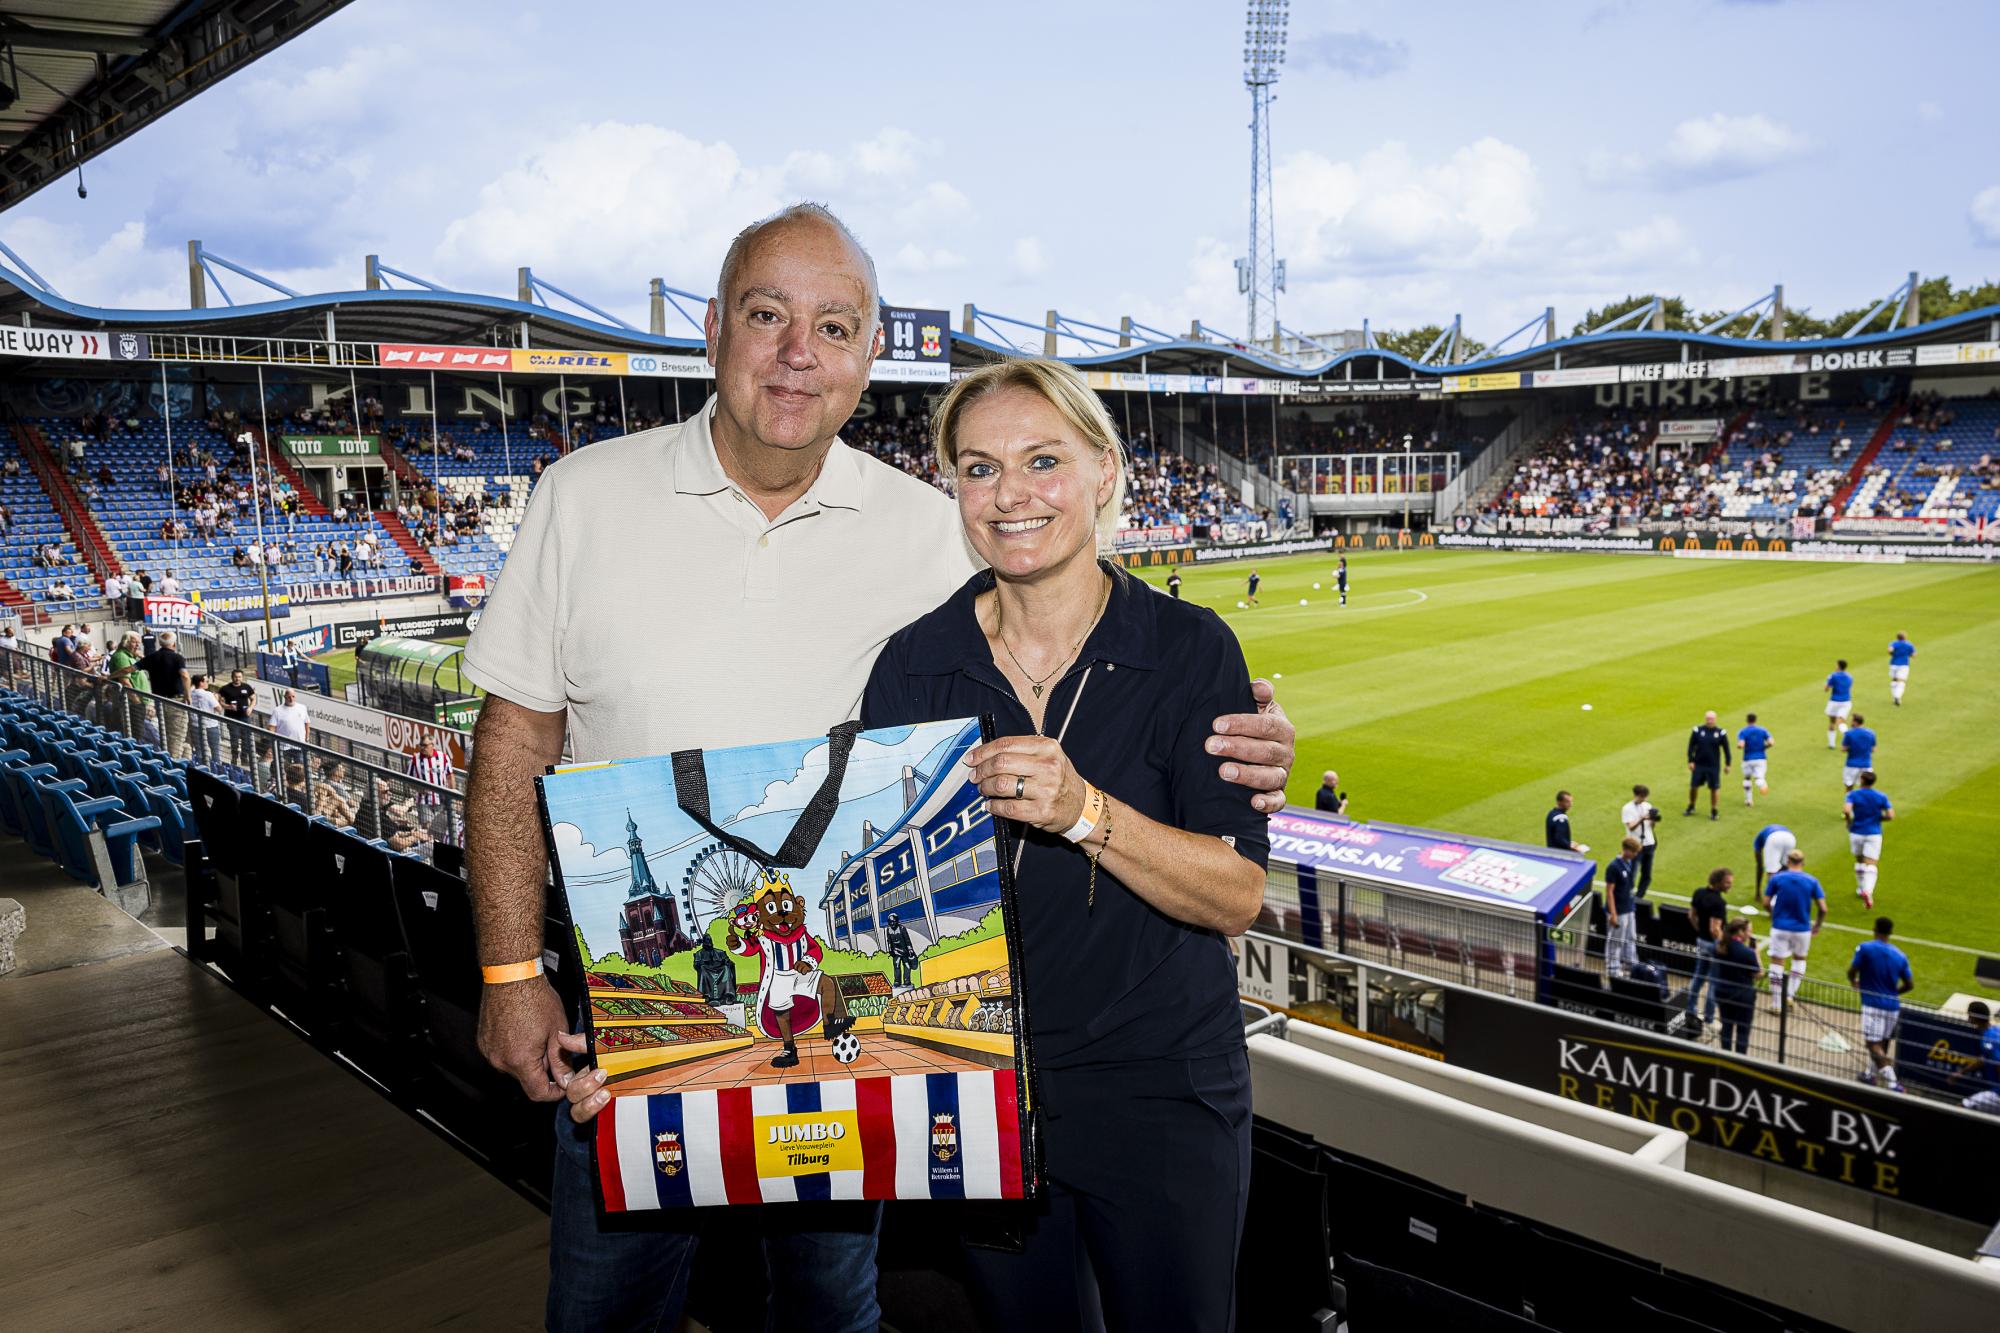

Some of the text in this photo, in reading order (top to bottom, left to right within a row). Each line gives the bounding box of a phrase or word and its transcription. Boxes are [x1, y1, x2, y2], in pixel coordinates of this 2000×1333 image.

[23, 332, 73, 354] WAY
[558, 356, 612, 367] RIEL
[661, 361, 701, 373] Bressers
[1811, 350, 1883, 371] BOREK
[289, 440, 370, 454] TOTO TOTO
[288, 580, 353, 602] WILLEM
[357, 579, 368, 598] II
[149, 602, 199, 625] 1896
[380, 618, 464, 632] WIE VERDEDIGT JOUW
[345, 629, 375, 639] CUBICS
[347, 718, 354, 728] to
[354, 718, 364, 730] the
[1290, 821, 1335, 835] ONZE
[1662, 939, 1701, 953] BOREK
[1557, 1000, 1598, 1017] BOREK
[1613, 1013, 1657, 1031] BOREK
[1558, 1038, 1901, 1159] KAMILDAK B.V.
[768, 1121, 845, 1144] JUMBO
[1558, 1074, 1899, 1196] RENOVATIE
[796, 1142, 835, 1151] Vrouweplein
[787, 1153, 830, 1166] Tilburg
